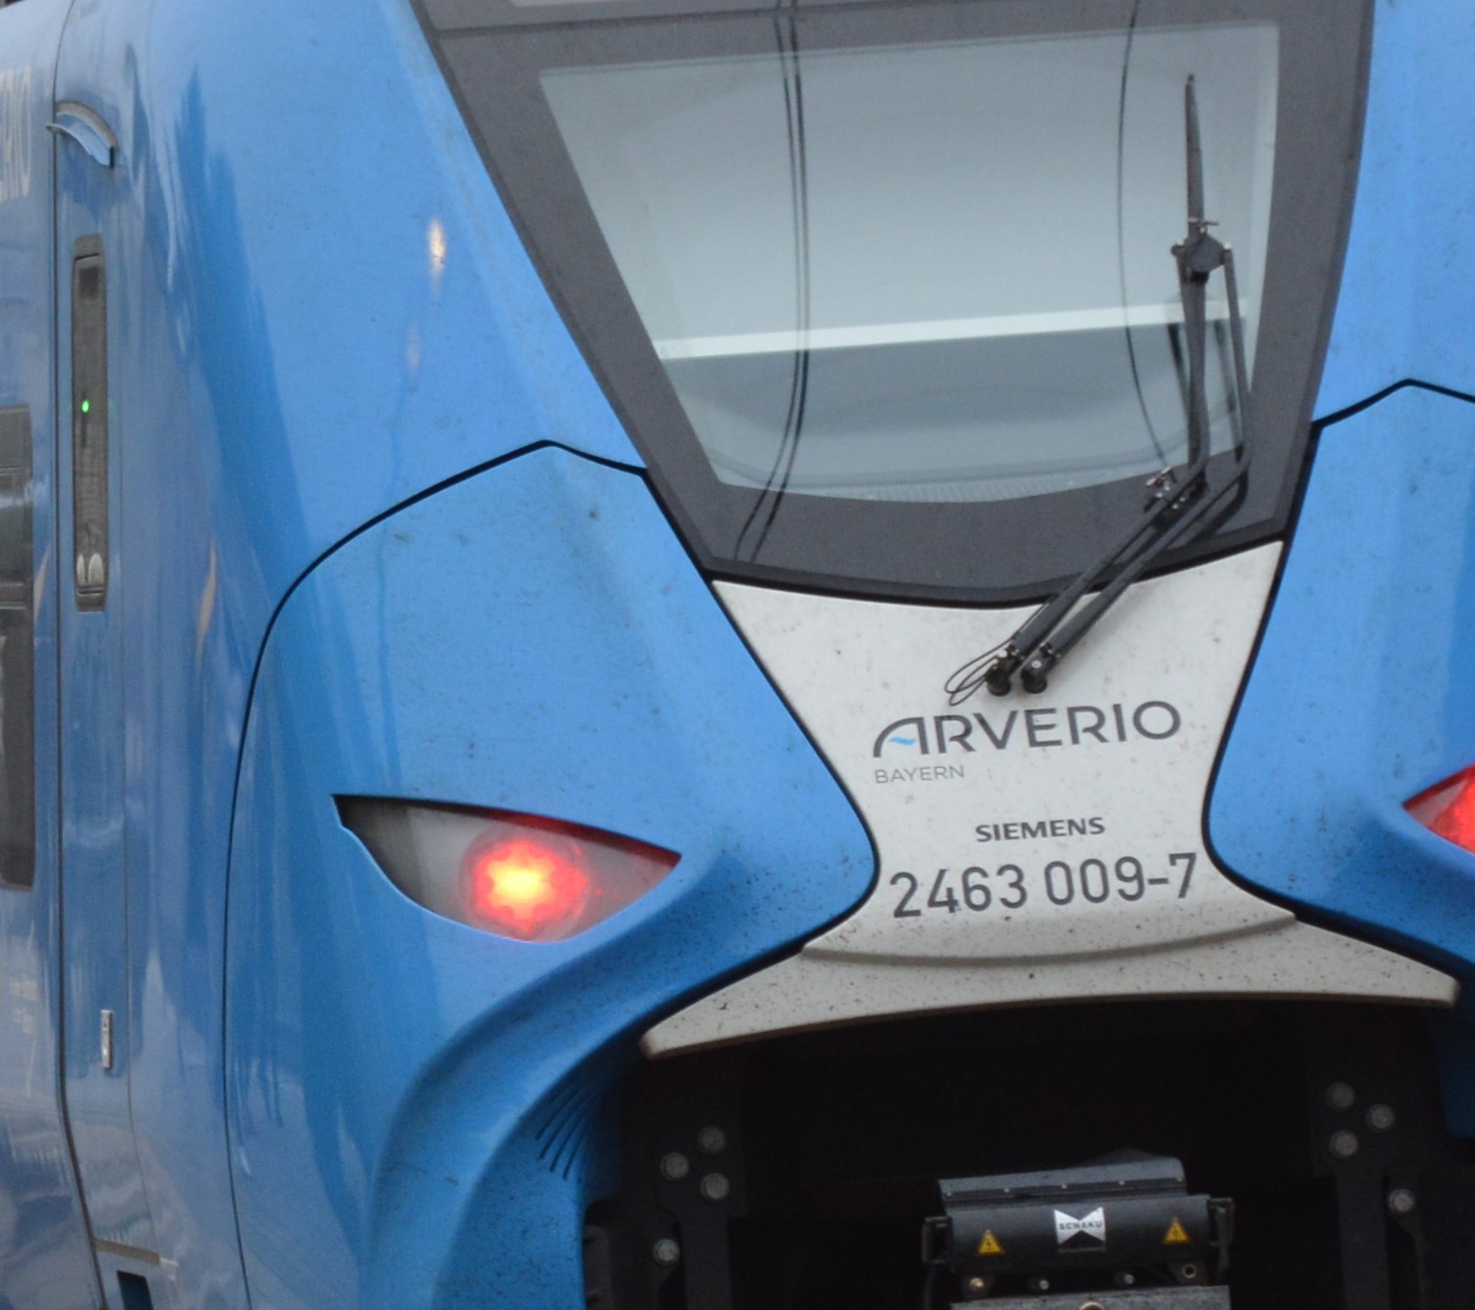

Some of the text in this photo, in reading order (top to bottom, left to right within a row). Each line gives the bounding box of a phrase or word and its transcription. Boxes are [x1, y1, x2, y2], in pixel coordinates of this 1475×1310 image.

[873, 700, 1182, 758] ARVERIO
[875, 765, 965, 784] BAYERN
[975, 817, 1106, 843] SIEMENS
[890, 852, 1198, 918] 2463 009-7
